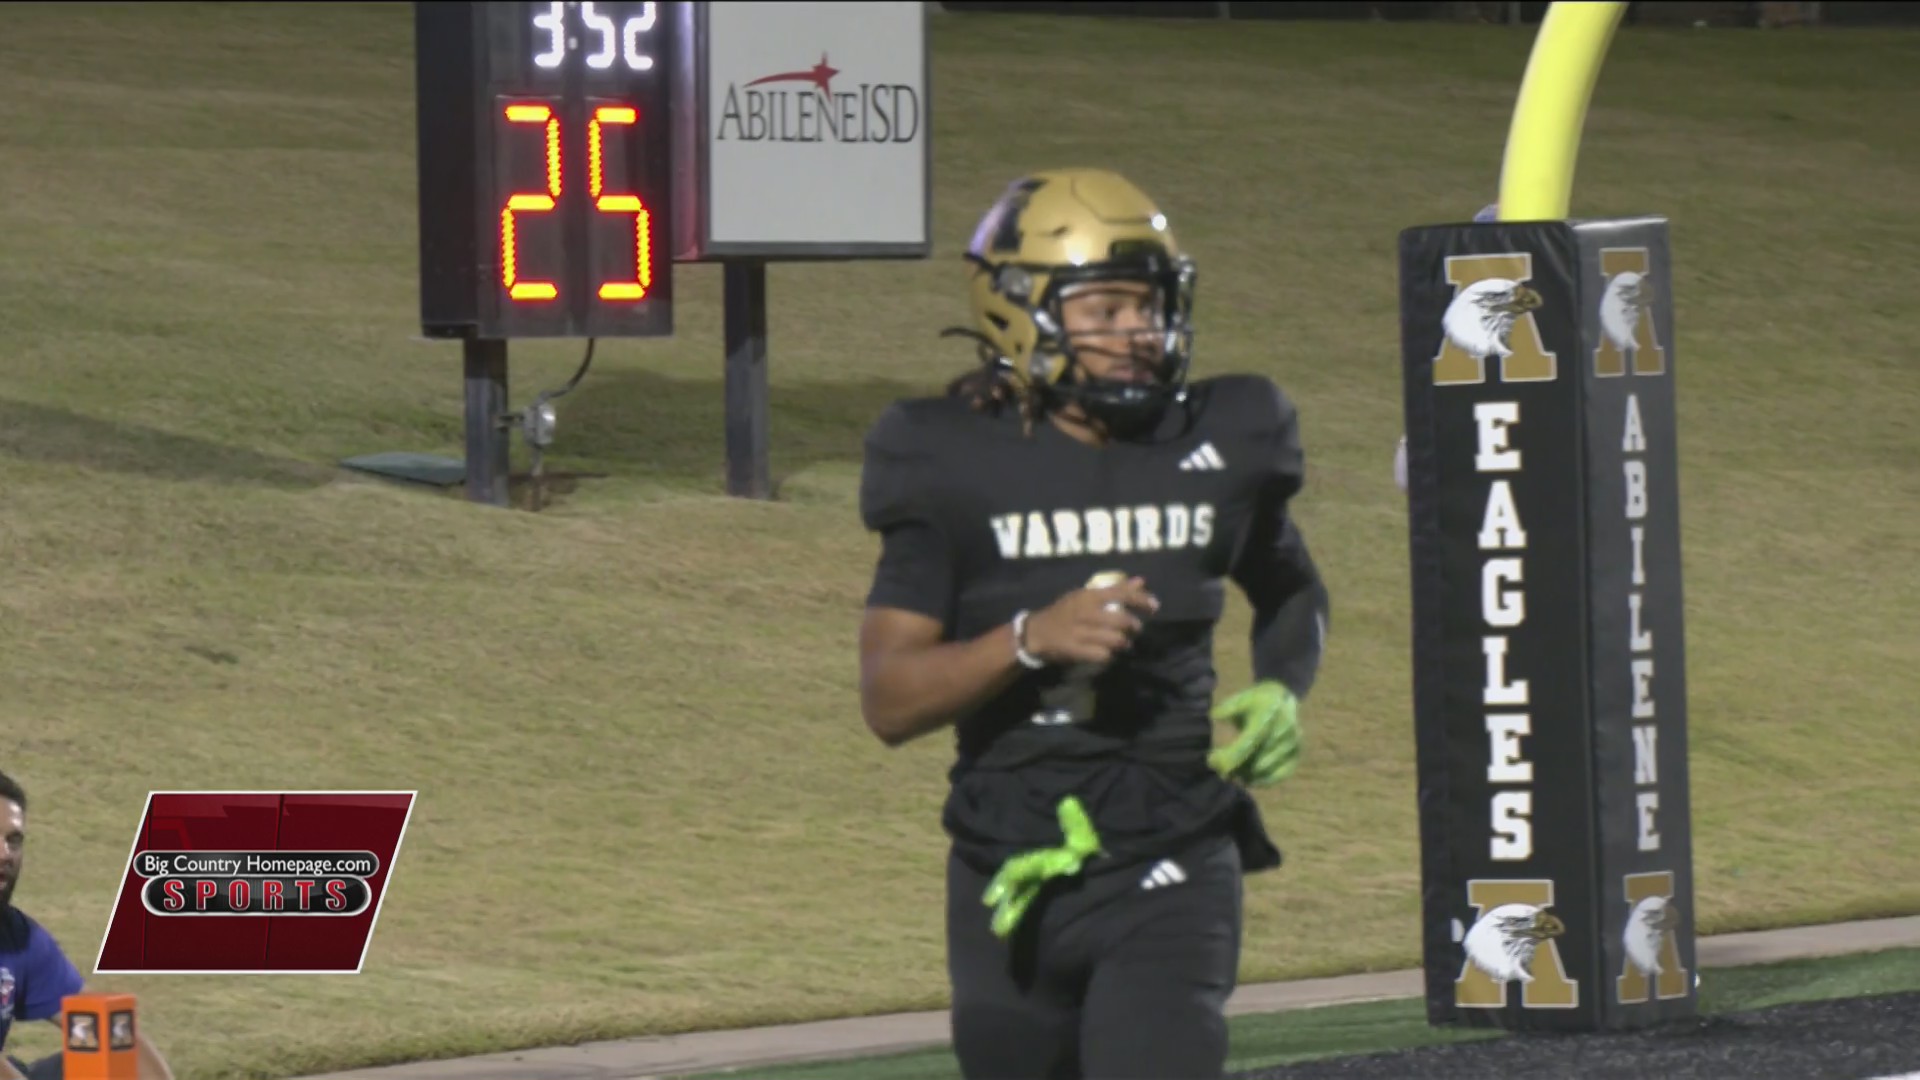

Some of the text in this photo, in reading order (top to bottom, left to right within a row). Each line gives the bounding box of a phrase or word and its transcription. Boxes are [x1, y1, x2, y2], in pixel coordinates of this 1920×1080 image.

[533, 1, 656, 69] 3:52
[501, 105, 651, 300] 25
[991, 504, 1216, 559] WARBIRDS
[1622, 394, 1660, 852] ABILENE
[1473, 402, 1534, 861] EAGLES
